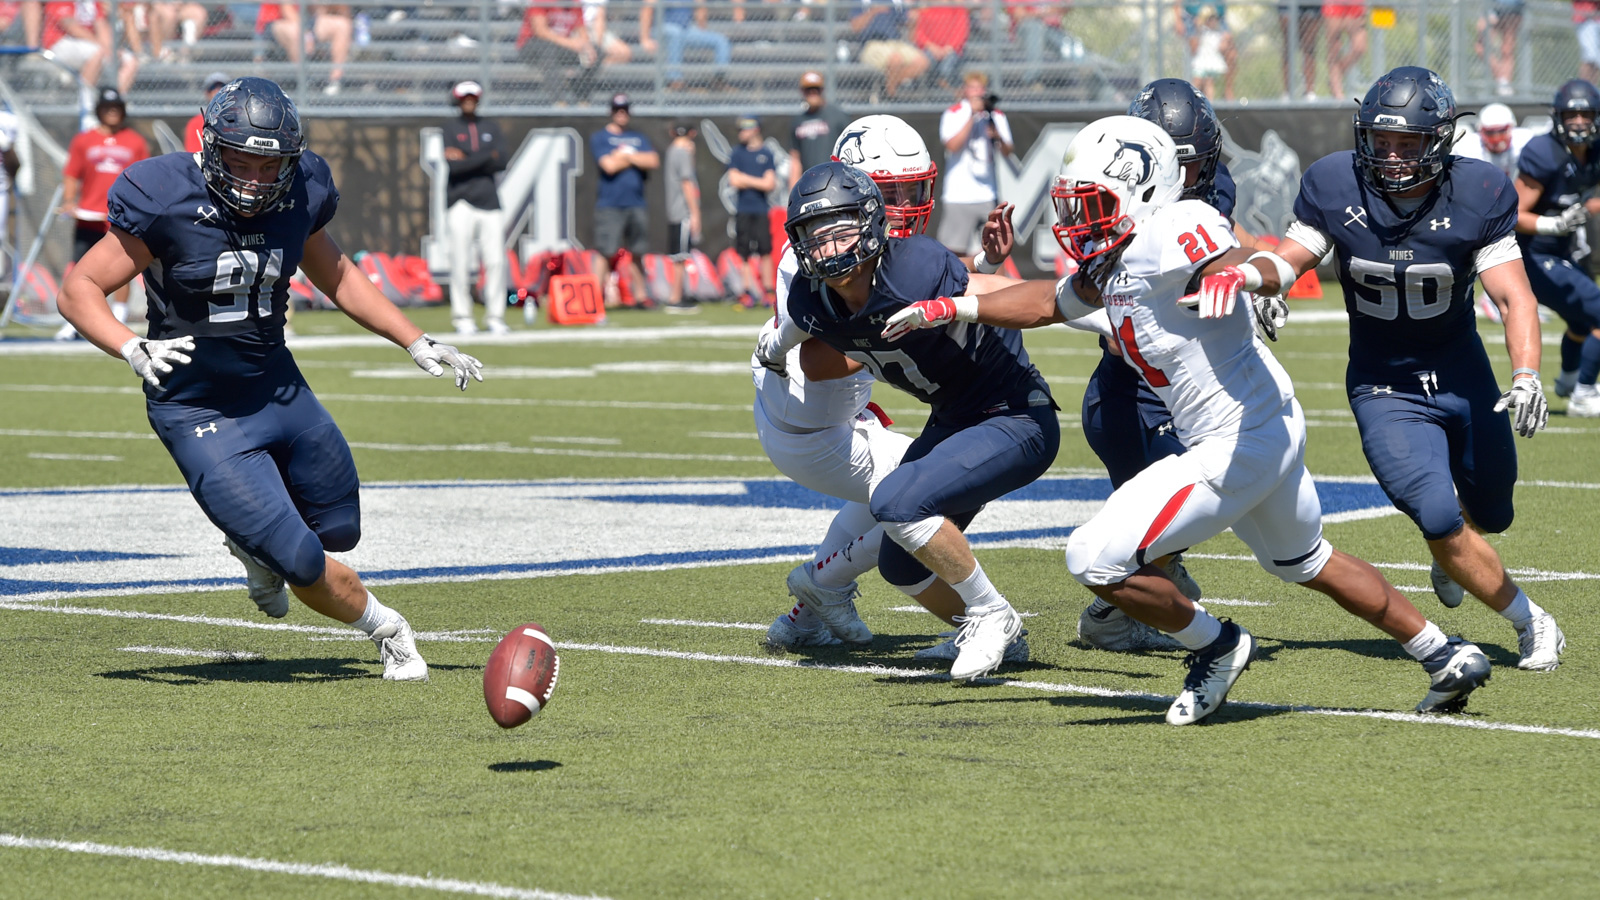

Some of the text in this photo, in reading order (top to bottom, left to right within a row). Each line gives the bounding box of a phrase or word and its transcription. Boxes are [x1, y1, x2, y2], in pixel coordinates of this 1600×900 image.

[253, 139, 274, 147] MINES
[241, 234, 266, 246] MINES
[1177, 224, 1219, 264] 21
[1388, 250, 1414, 260] MINES
[207, 248, 284, 323] 91
[561, 282, 597, 315] 20
[1349, 256, 1455, 320] 50
[1110, 316, 1171, 388] 1
